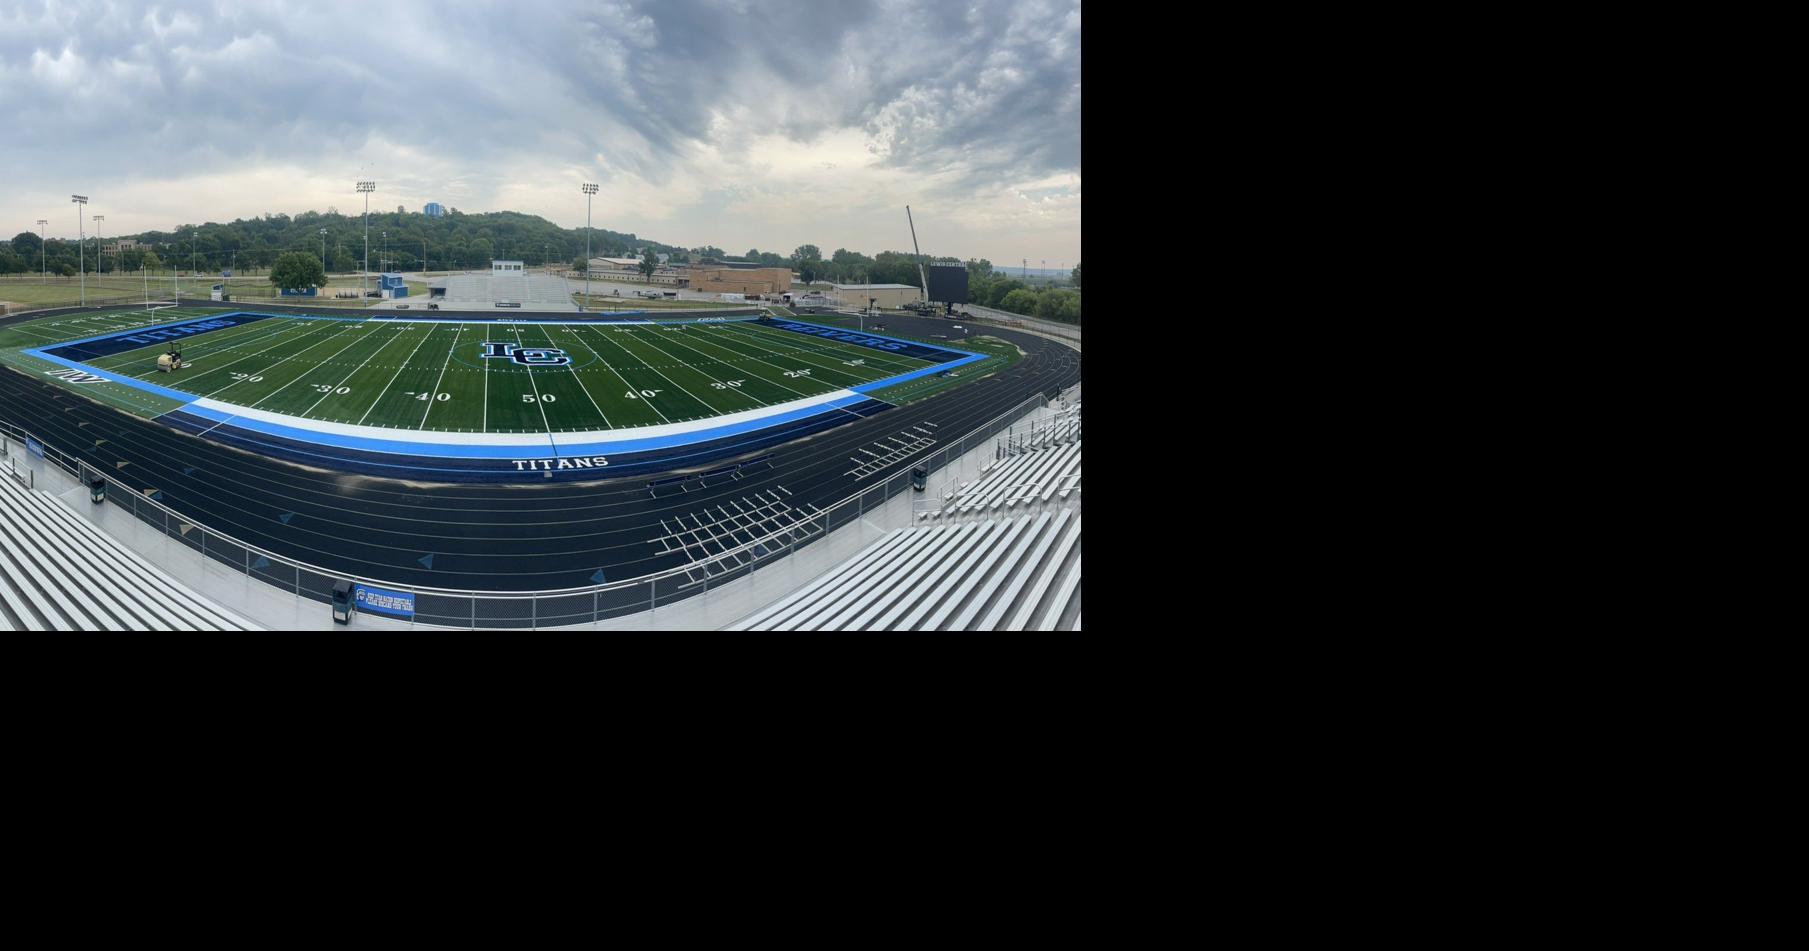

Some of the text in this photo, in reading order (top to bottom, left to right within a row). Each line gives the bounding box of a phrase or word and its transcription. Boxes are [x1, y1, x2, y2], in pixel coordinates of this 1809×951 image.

[231, 373, 264, 383] 20
[783, 369, 811, 378] 20
[316, 384, 351, 395] 30
[710, 380, 742, 389] 30
[415, 392, 451, 402] 40
[522, 393, 556, 403] 50
[624, 389, 656, 399] 40
[512, 456, 609, 471] TITANS
